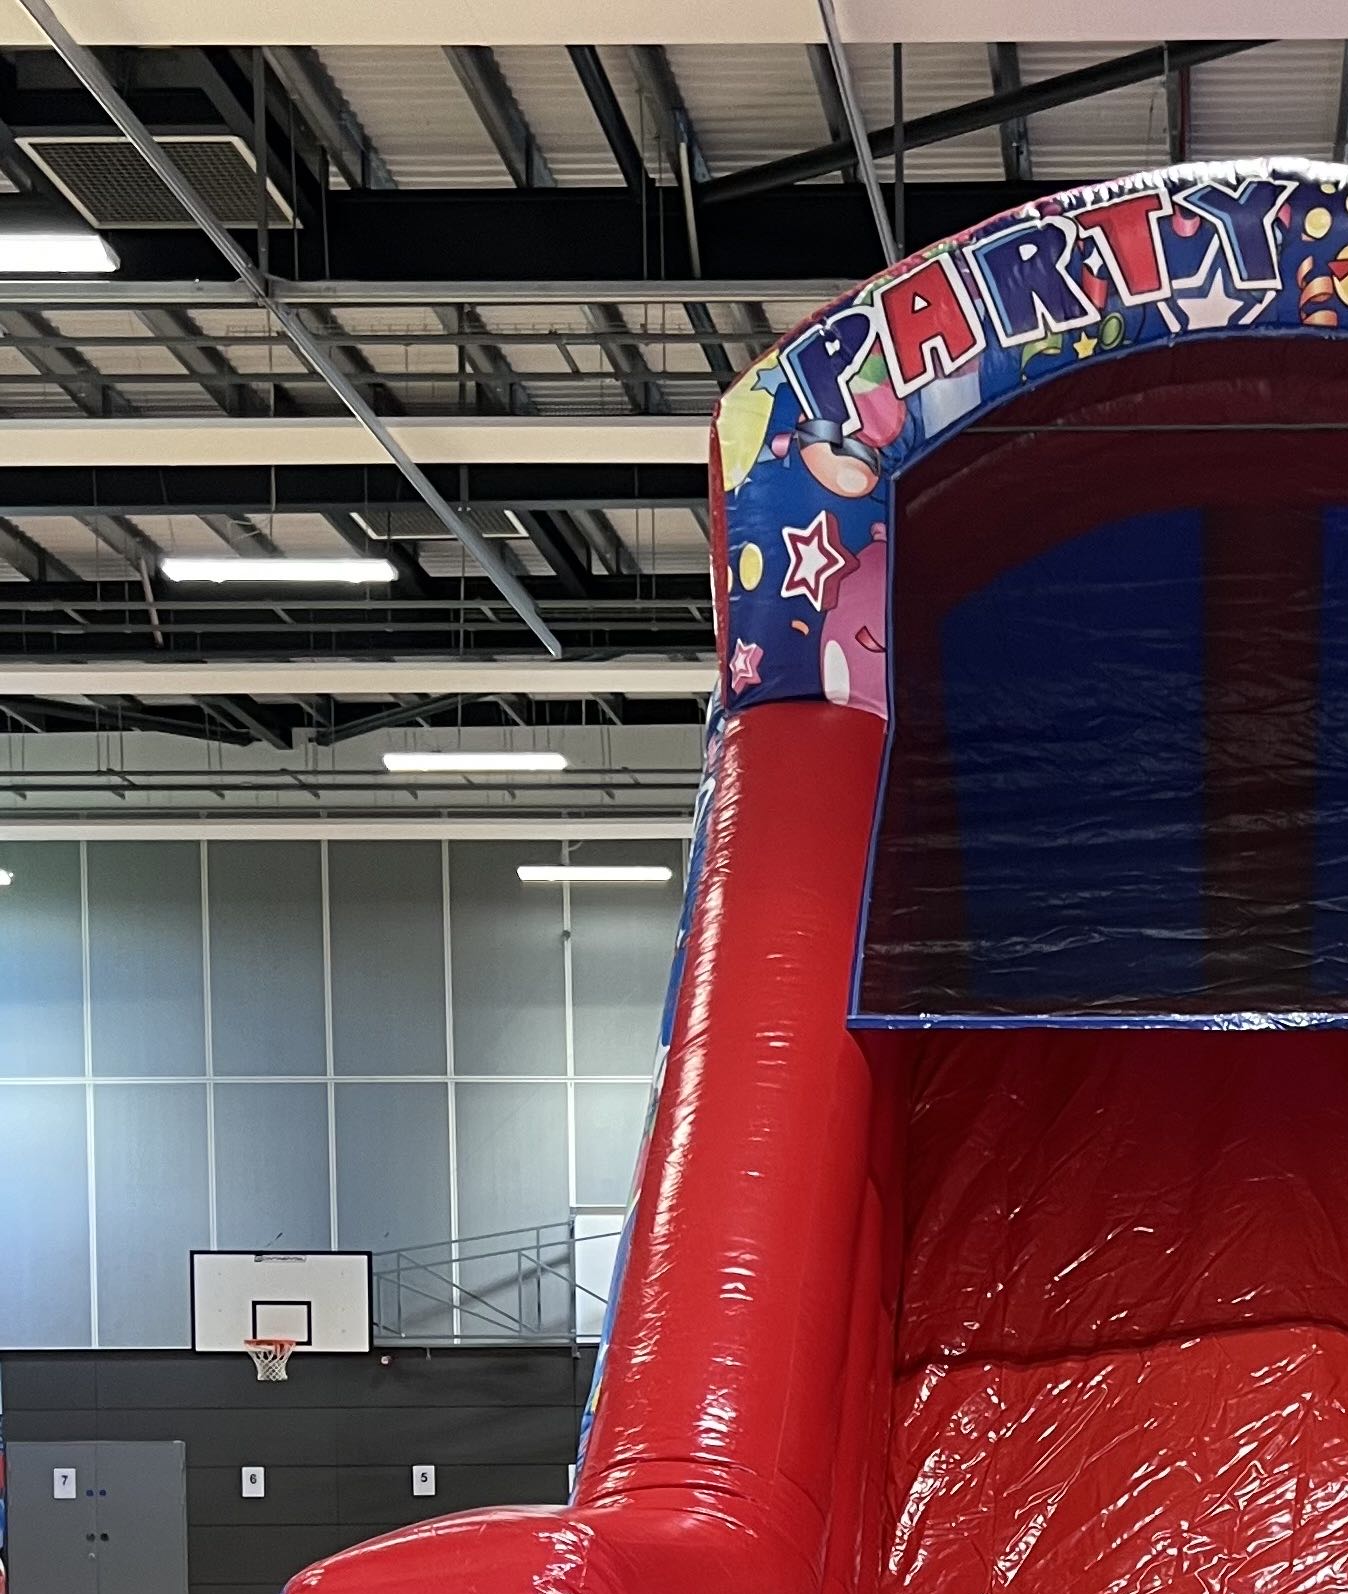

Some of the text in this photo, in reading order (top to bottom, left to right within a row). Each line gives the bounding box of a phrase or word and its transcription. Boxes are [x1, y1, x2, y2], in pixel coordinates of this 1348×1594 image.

[778, 179, 1298, 437] PARTY
[61, 1474, 69, 1486] 7
[249, 1473, 257, 1485] 6
[420, 1472, 428, 1483] 5
